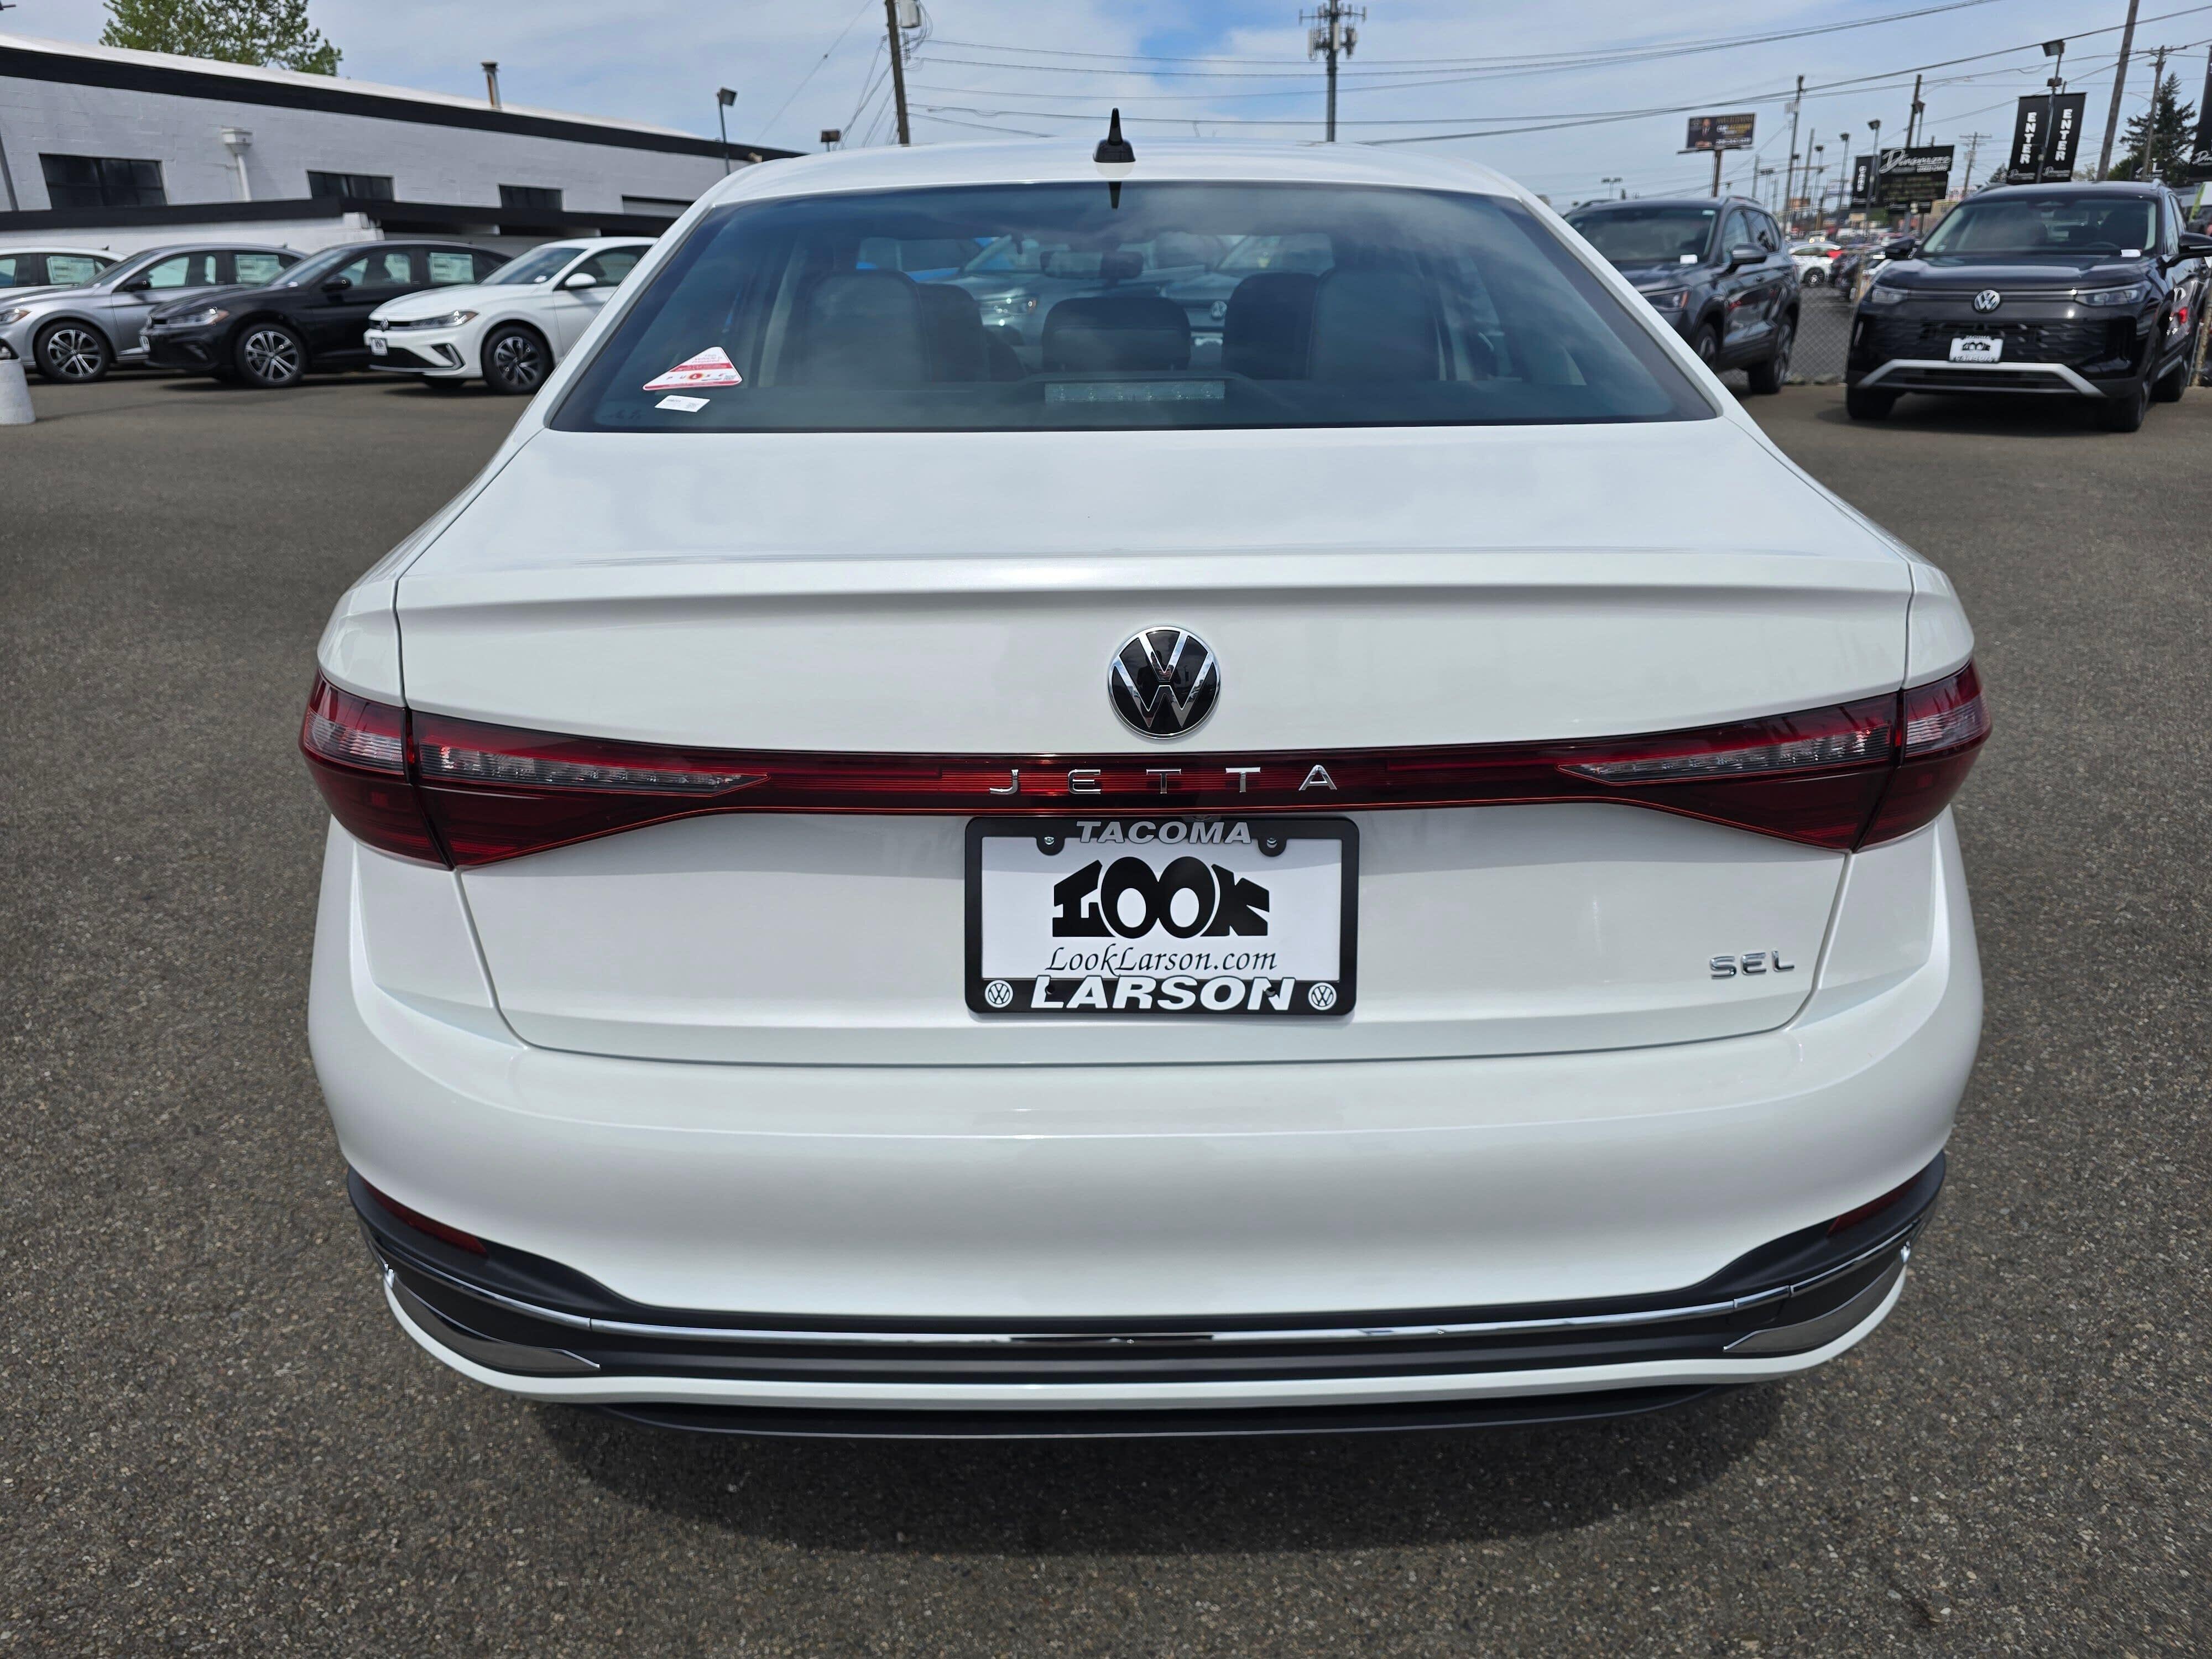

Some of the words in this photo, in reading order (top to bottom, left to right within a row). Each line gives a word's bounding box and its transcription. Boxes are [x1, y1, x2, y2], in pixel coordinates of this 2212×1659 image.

[2020, 112, 2037, 164] ENTER
[2055, 108, 2073, 161] ENTER
[989, 764, 1338, 795] JETTA
[1076, 821, 1252, 844] TACOMA
[1052, 856, 1270, 939] LOOK
[1045, 943, 1277, 976] LookLarson.com
[1710, 951, 1795, 979] SEL
[1030, 975, 1296, 1011] LARSON
